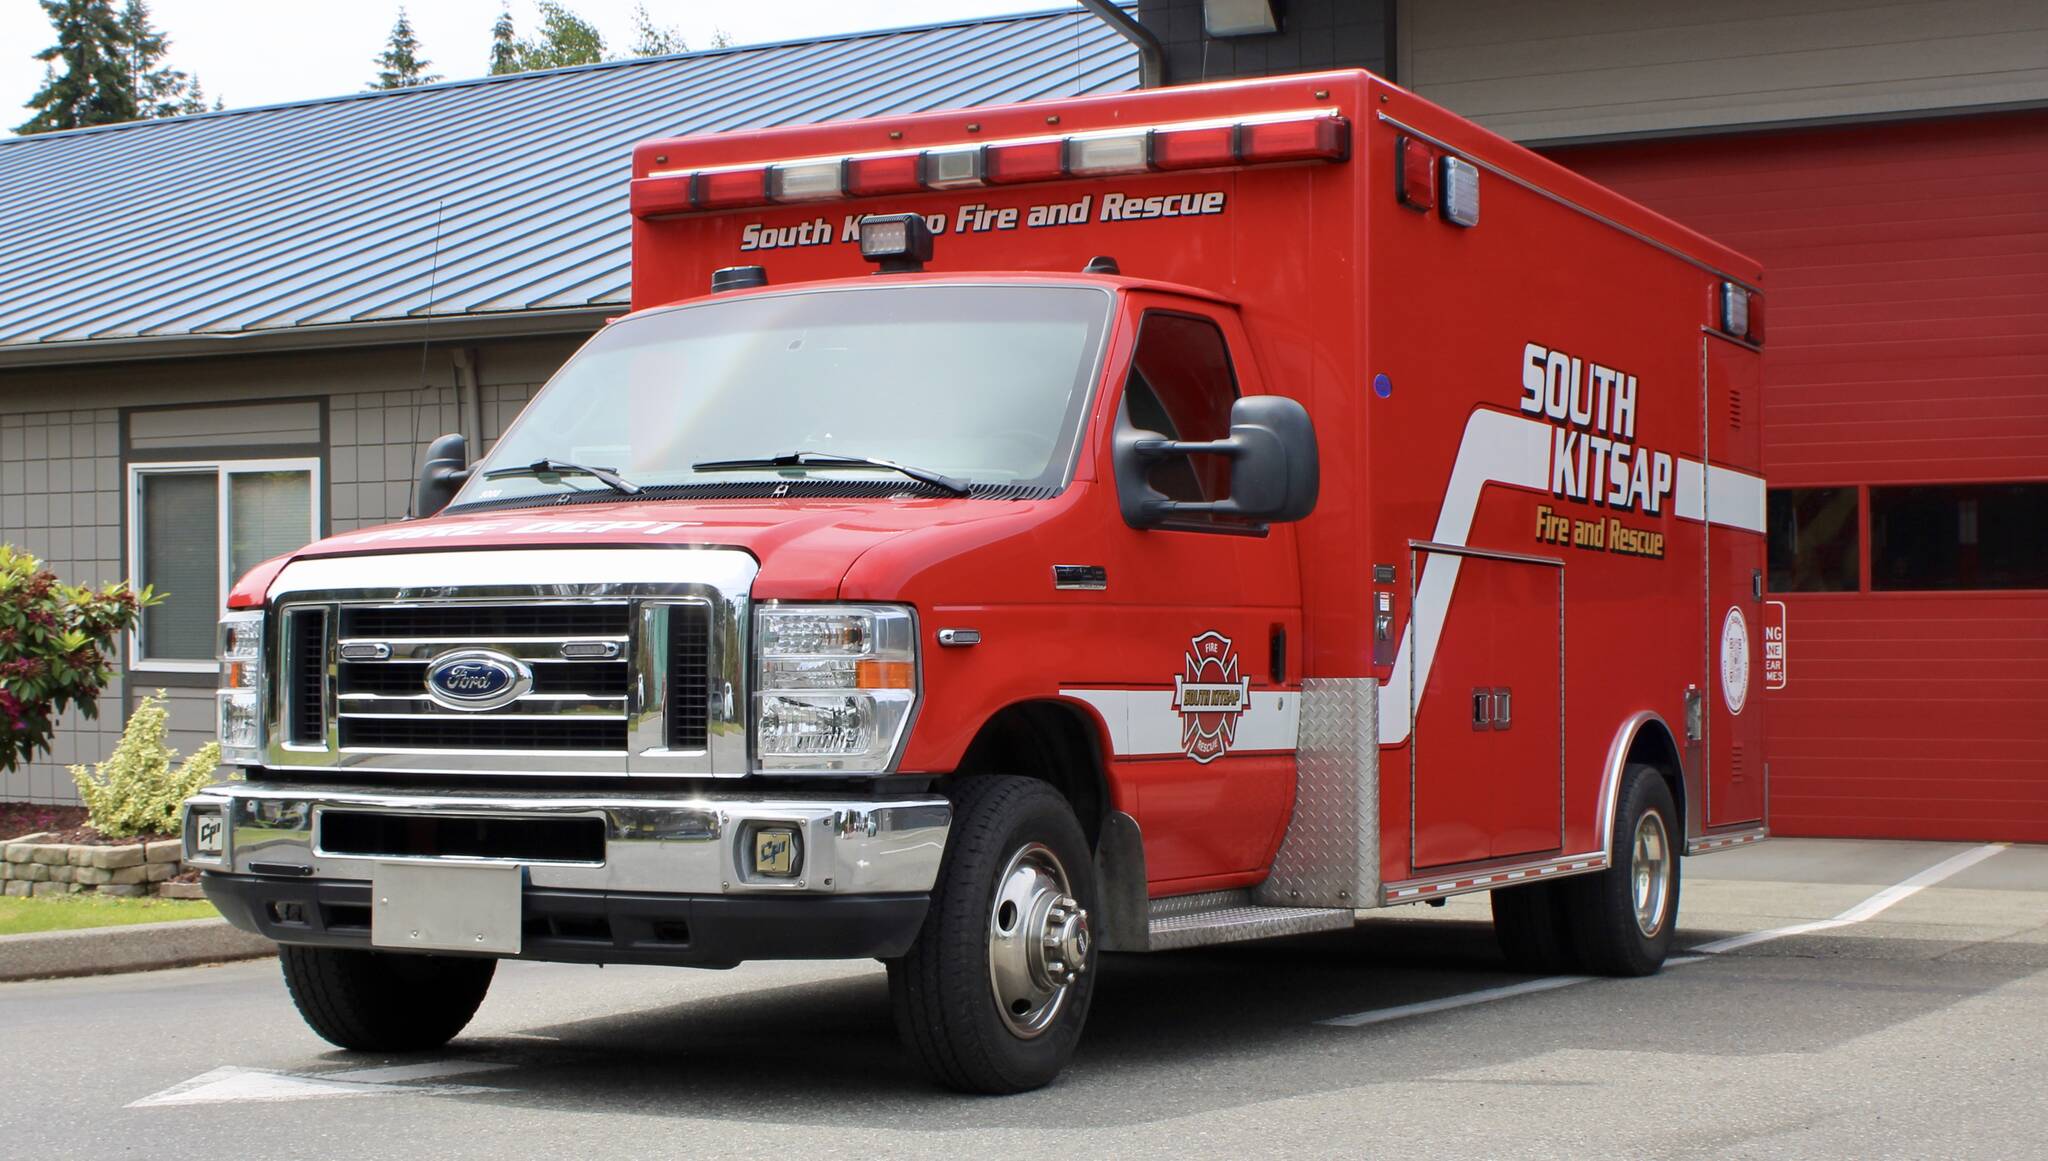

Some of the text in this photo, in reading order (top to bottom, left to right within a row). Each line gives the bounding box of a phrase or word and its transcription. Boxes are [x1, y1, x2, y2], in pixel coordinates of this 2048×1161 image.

[740, 218, 833, 252] South
[955, 205, 1018, 234] Fire
[1027, 196, 1092, 228] and
[1099, 191, 1227, 223] Rescue
[1520, 342, 1638, 443] SOUTH
[1552, 427, 1673, 516] KITSAP
[1536, 505, 1665, 559] Fire and Rescue
[1204, 642, 1218, 653] FIRE
[447, 665, 492, 689] Ford
[1765, 660, 1781, 670] EAR
[1766, 672, 1783, 681] MES
[1183, 689, 1211, 706] SOUTH
